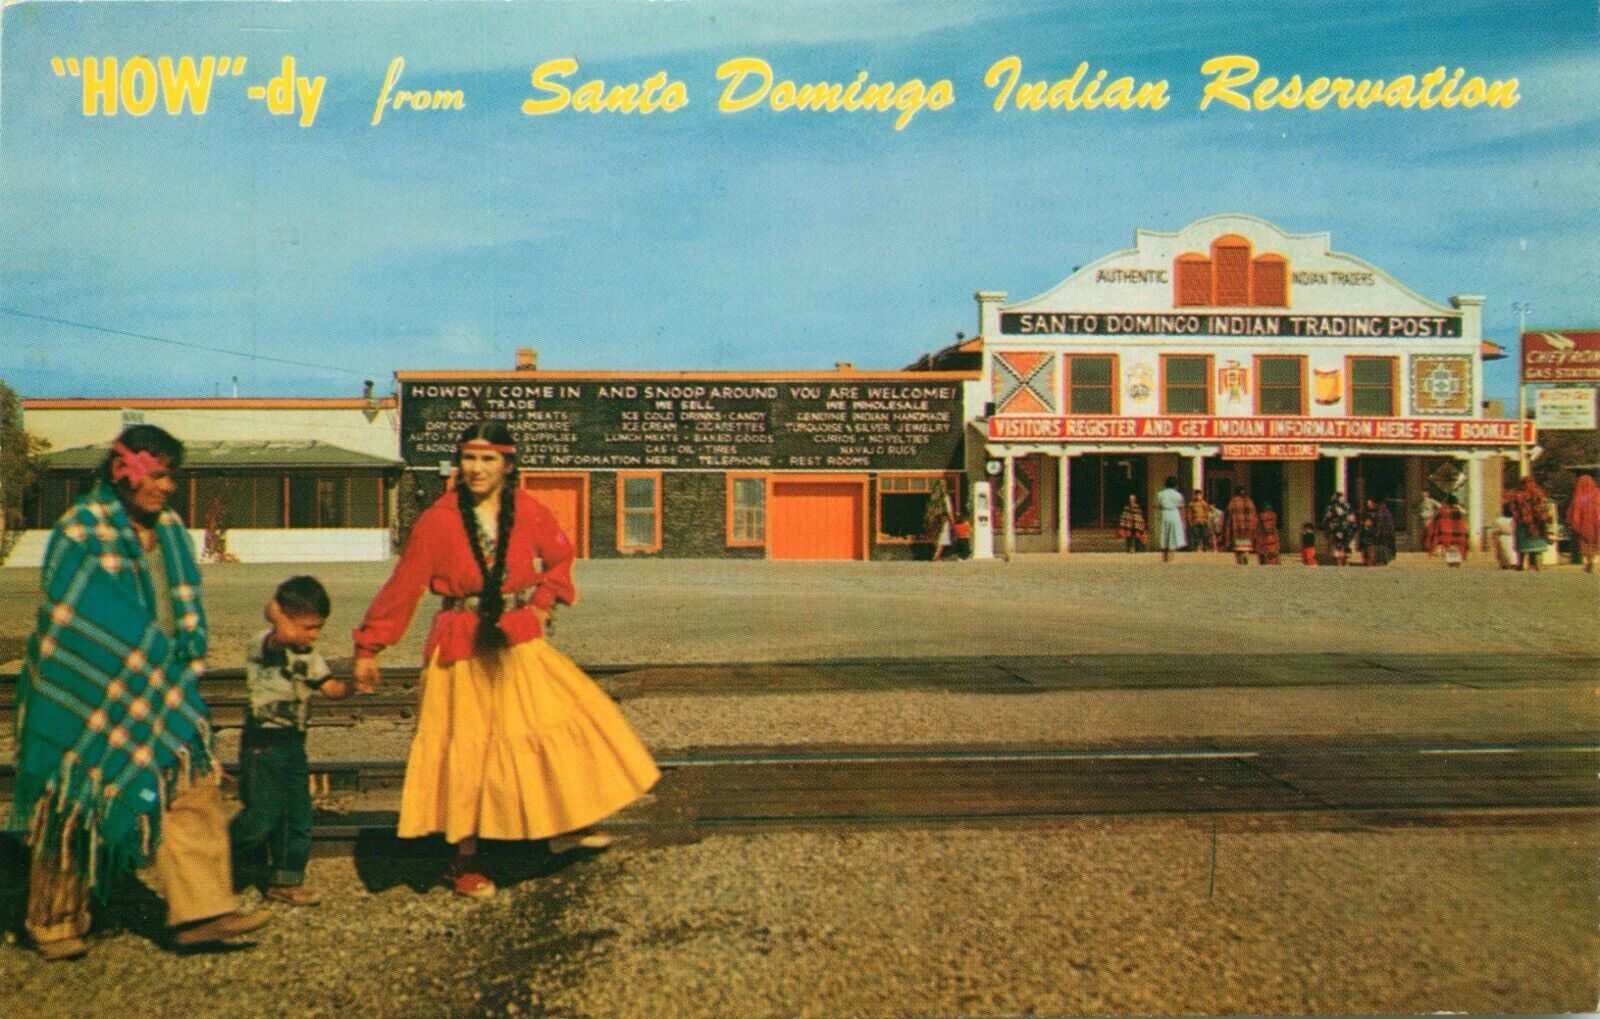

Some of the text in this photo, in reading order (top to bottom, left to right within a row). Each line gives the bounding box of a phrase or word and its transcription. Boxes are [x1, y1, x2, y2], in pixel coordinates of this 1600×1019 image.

[1096, 269, 1376, 287] AUTHENTIC INDIAN TRADERS
[1020, 315, 1454, 337] SANTO DOMINGO INDIAN TRADING POST.
[499, 386, 554, 399] COME
[560, 387, 581, 399] IN
[598, 387, 638, 399] AND
[645, 387, 705, 400] SNOOP
[710, 388, 778, 400] AROUND
[790, 388, 821, 400] YOU
[829, 388, 860, 400] ARE
[867, 388, 957, 400] WELCOME!
[489, 400, 536, 410] TRADE
[655, 400, 715, 410] WE SELL
[826, 401, 929, 411] WE WHOLESALE
[528, 411, 568, 420] MEATS
[621, 411, 766, 421] ICE COLD DRINKS CANDY
[796, 412, 950, 422] GENUINE INDIAN HANDMADE
[622, 422, 766, 432] ICE CREAM CIGARETTES
[785, 423, 846, 433] TURQUOISE
[855, 424, 891, 433] SILVER
[897, 424, 950, 433] JEWELRY
[994, 418, 1061, 437] VISITORS
[1066, 418, 1137, 437] REGISTER
[1142, 418, 1175, 437] AND
[1178, 419, 1208, 437] GET
[1212, 419, 1266, 437] INDIAN
[1269, 419, 1372, 438] INFORMATION
[1459, 422, 1529, 440] BOOKLE
[523, 433, 578, 443] SUPPLIES
[605, 433, 775, 443] LUNCH MEATS BAKED GOODS
[813, 434, 929, 444] CURIOS NOVELTIES
[525, 444, 570, 453] STOVES
[645, 444, 668, 454] GAS
[839, 445, 918, 455] NAVAJO RUGS
[1222, 444, 1315, 457] VISITORS WELCOME
[521, 455, 870, 466] GET INFORMATION HERE TELEPHONE REST ROOMS
